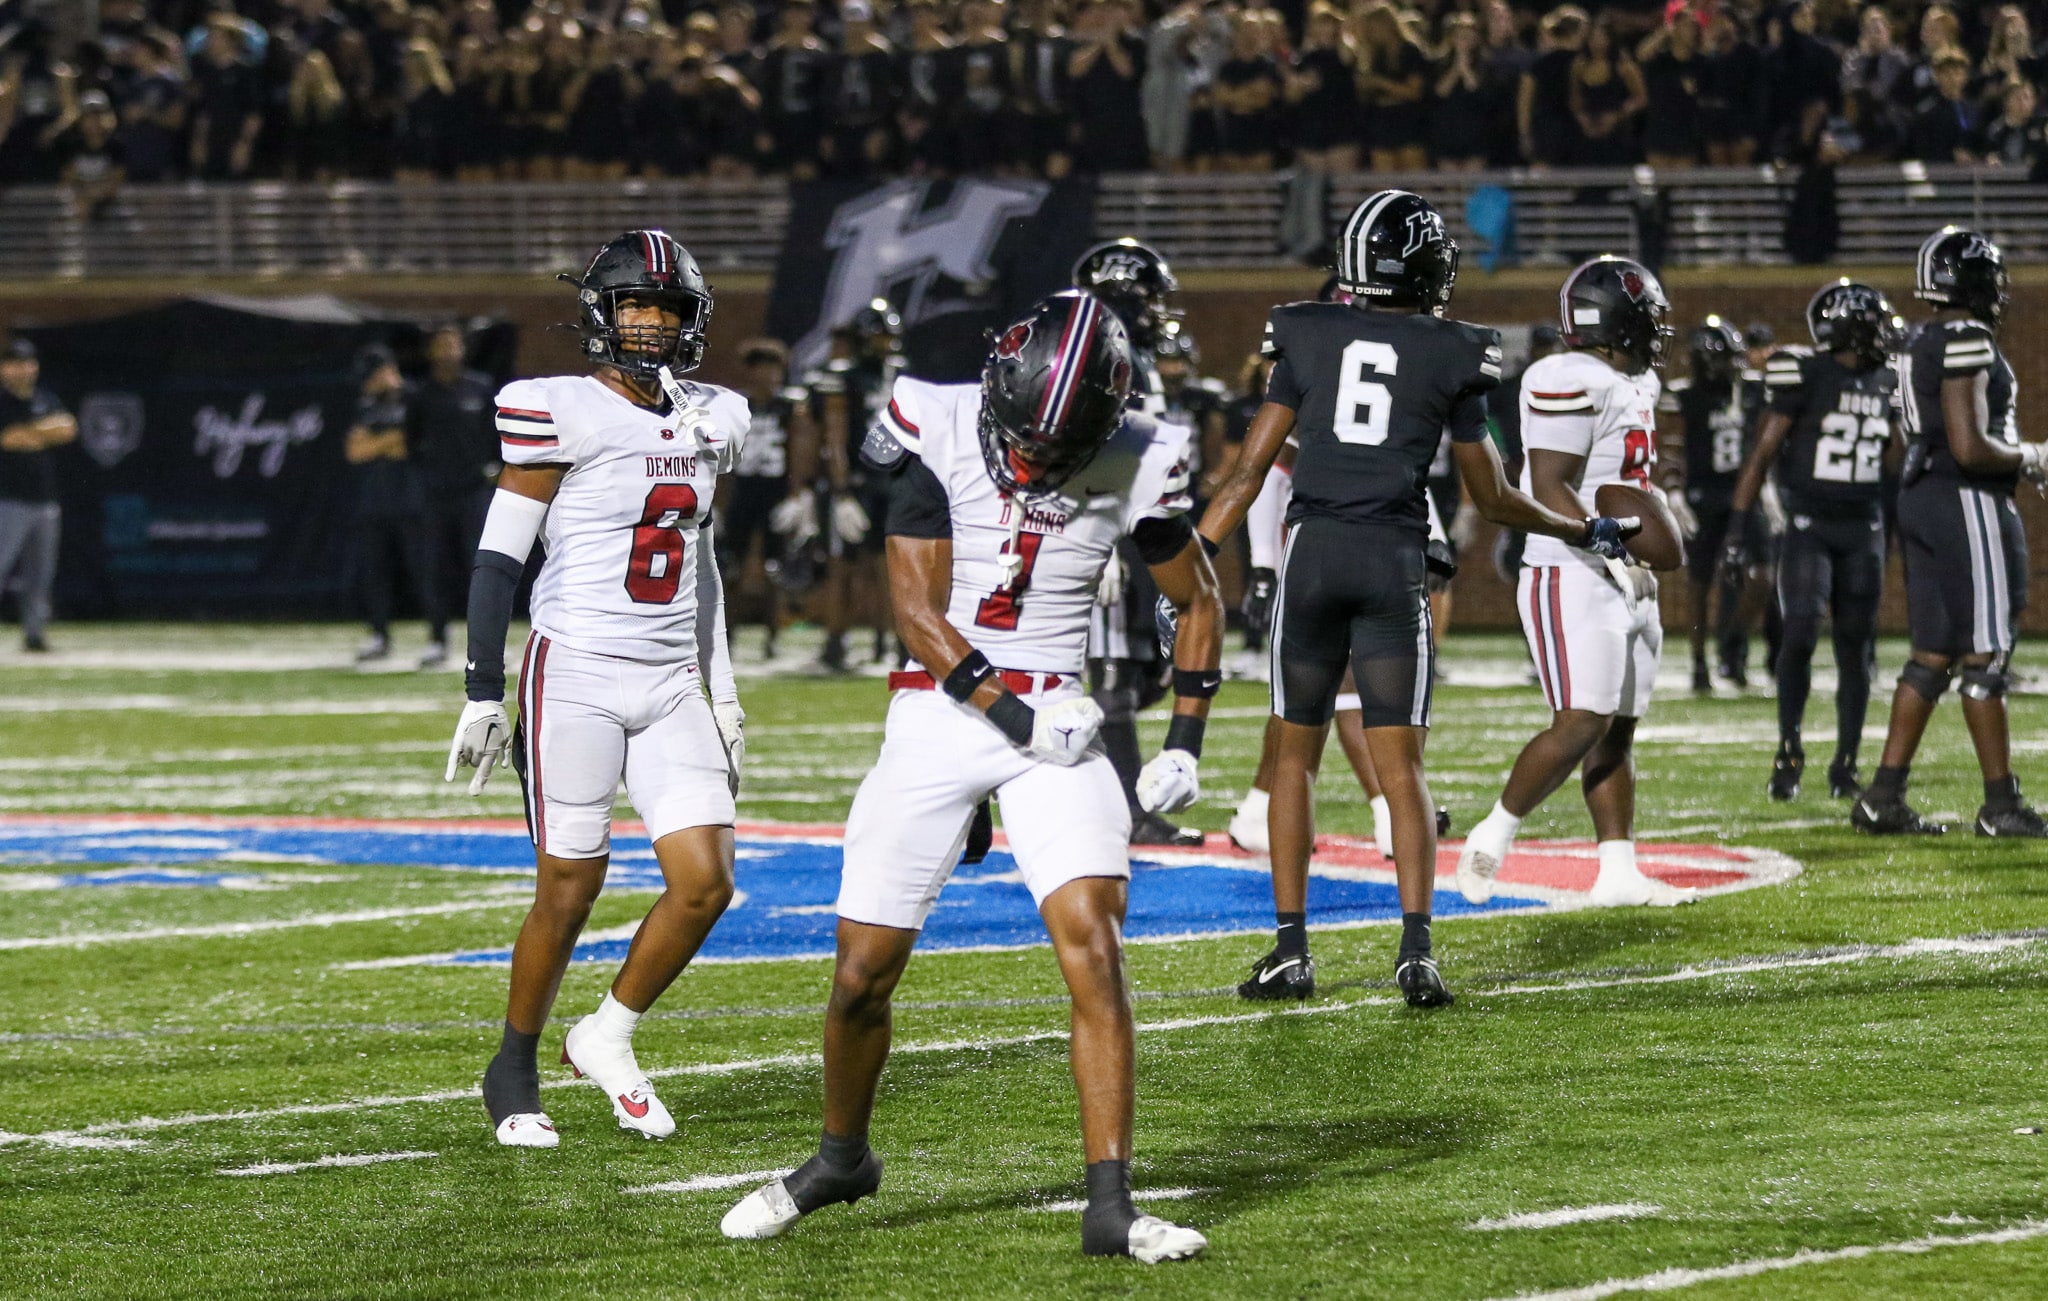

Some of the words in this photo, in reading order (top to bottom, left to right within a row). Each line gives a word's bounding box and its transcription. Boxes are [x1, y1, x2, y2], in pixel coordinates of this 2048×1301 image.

[1355, 286, 1393, 296] DOWN
[1333, 339, 1399, 446] 6
[645, 456, 696, 478] DEMONS
[1620, 429, 1657, 493] 9
[1813, 412, 1890, 483] 22
[624, 483, 698, 605] 6
[998, 504, 1067, 535] DMONS
[974, 532, 1044, 632] 1
